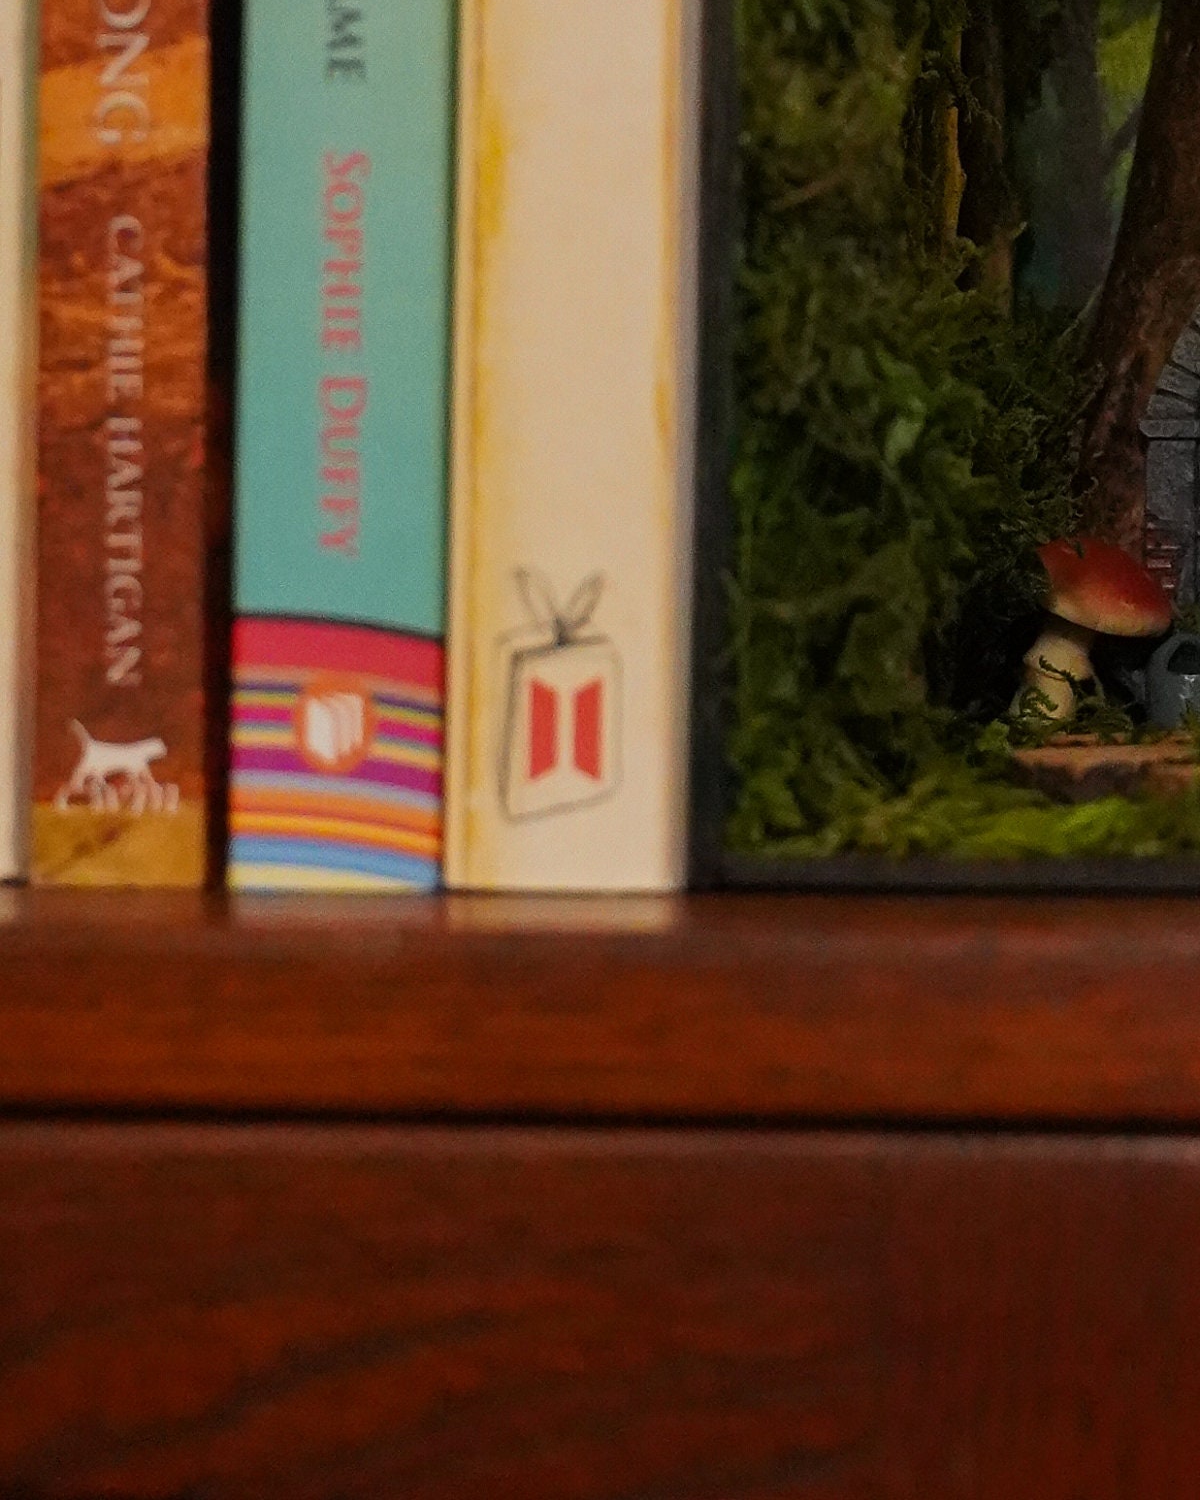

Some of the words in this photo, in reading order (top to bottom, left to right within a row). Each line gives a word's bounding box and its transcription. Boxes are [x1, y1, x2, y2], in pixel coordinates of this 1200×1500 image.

[103, 213, 146, 401] CATHIE
[319, 148, 373, 351] SOPHIE
[102, 415, 145, 688] HARTIGAN
[317, 374, 370, 561] DUFFY
